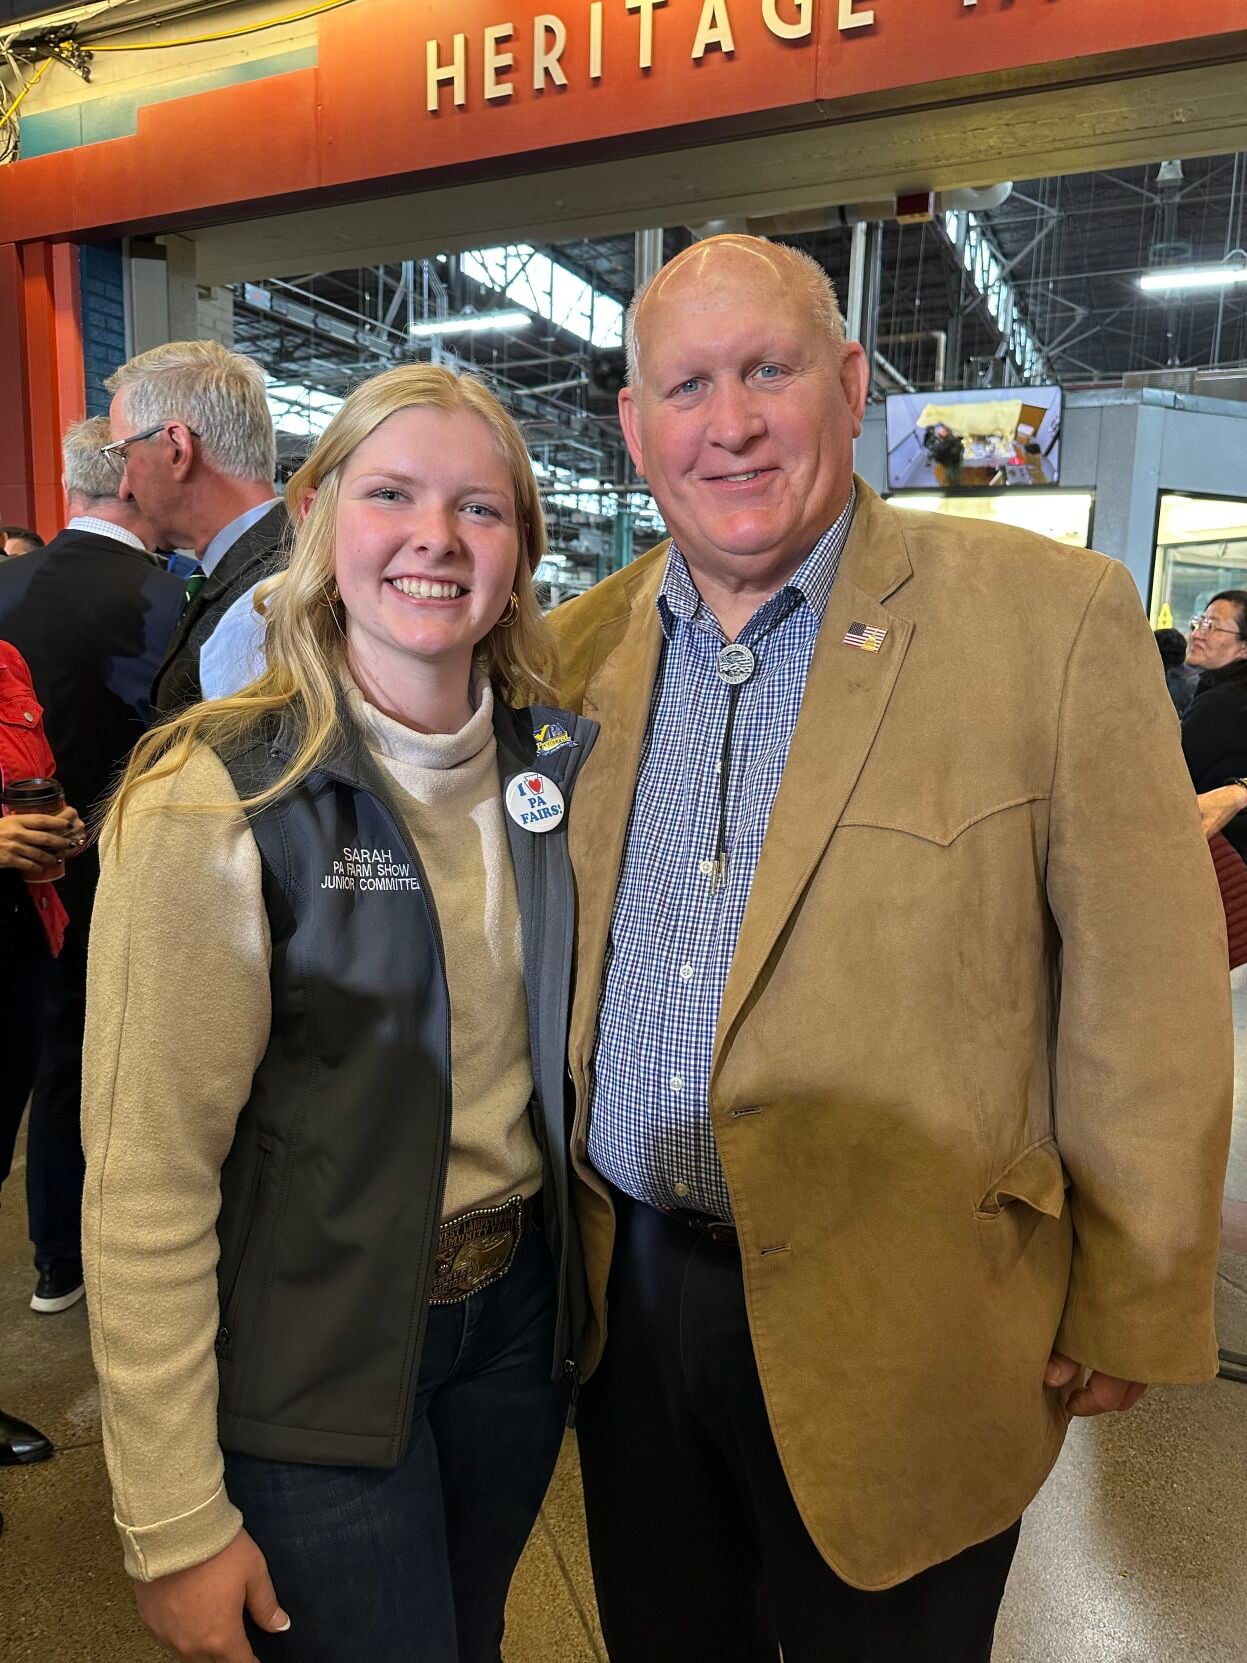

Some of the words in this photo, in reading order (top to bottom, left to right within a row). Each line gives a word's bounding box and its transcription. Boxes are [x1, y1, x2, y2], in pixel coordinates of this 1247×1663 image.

[517, 782, 527, 797] I
[528, 795, 547, 808] PA
[520, 804, 562, 824] FAIRS!
[343, 847, 393, 863] SARAH
[333, 861, 345, 875] PA
[347, 863, 372, 877] FARM
[377, 864, 410, 877] SHOW
[320, 875, 355, 891] JUNIOR
